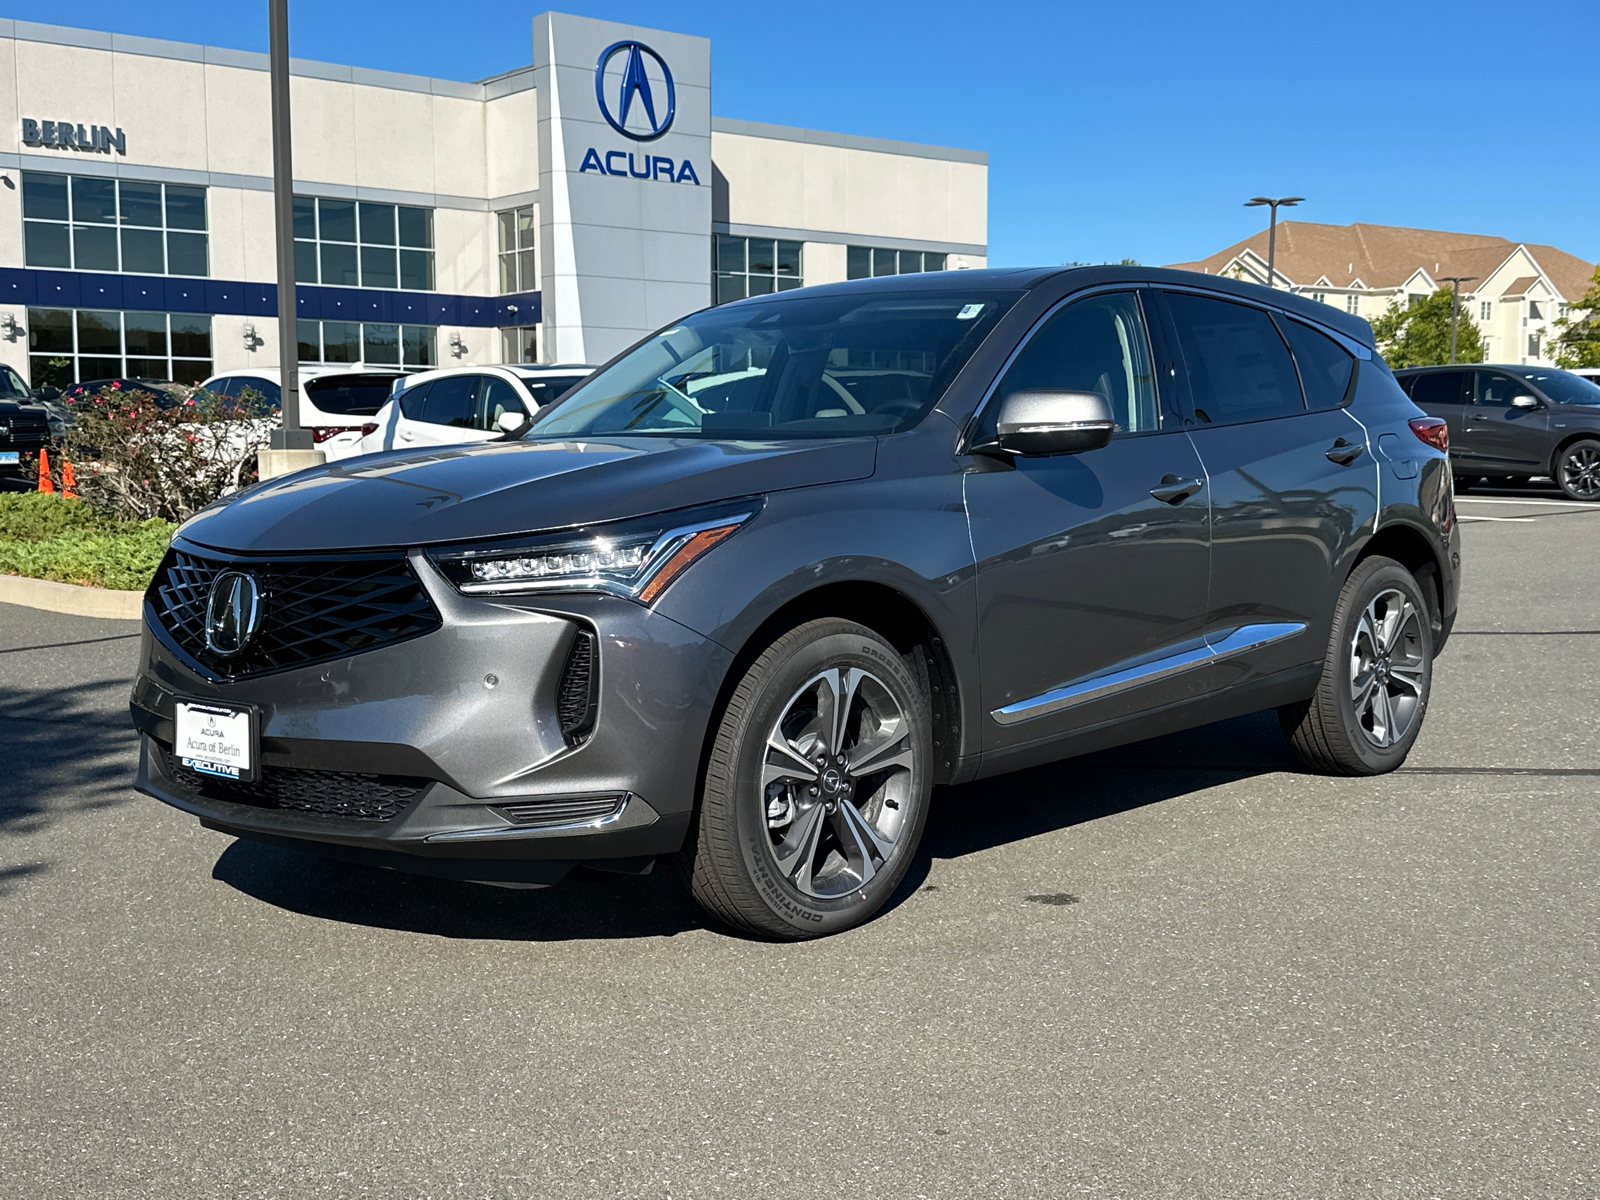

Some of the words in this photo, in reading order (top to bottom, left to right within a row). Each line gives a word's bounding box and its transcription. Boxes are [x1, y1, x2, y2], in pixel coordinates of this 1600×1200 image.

[22, 118, 125, 155] BERLIN
[579, 148, 700, 185] ACURA
[201, 728, 225, 738] ACURA
[187, 737, 207, 751] Acura
[209, 743, 216, 753] of
[218, 742, 241, 757] Berlin
[182, 757, 240, 776] EXECUTIVE
